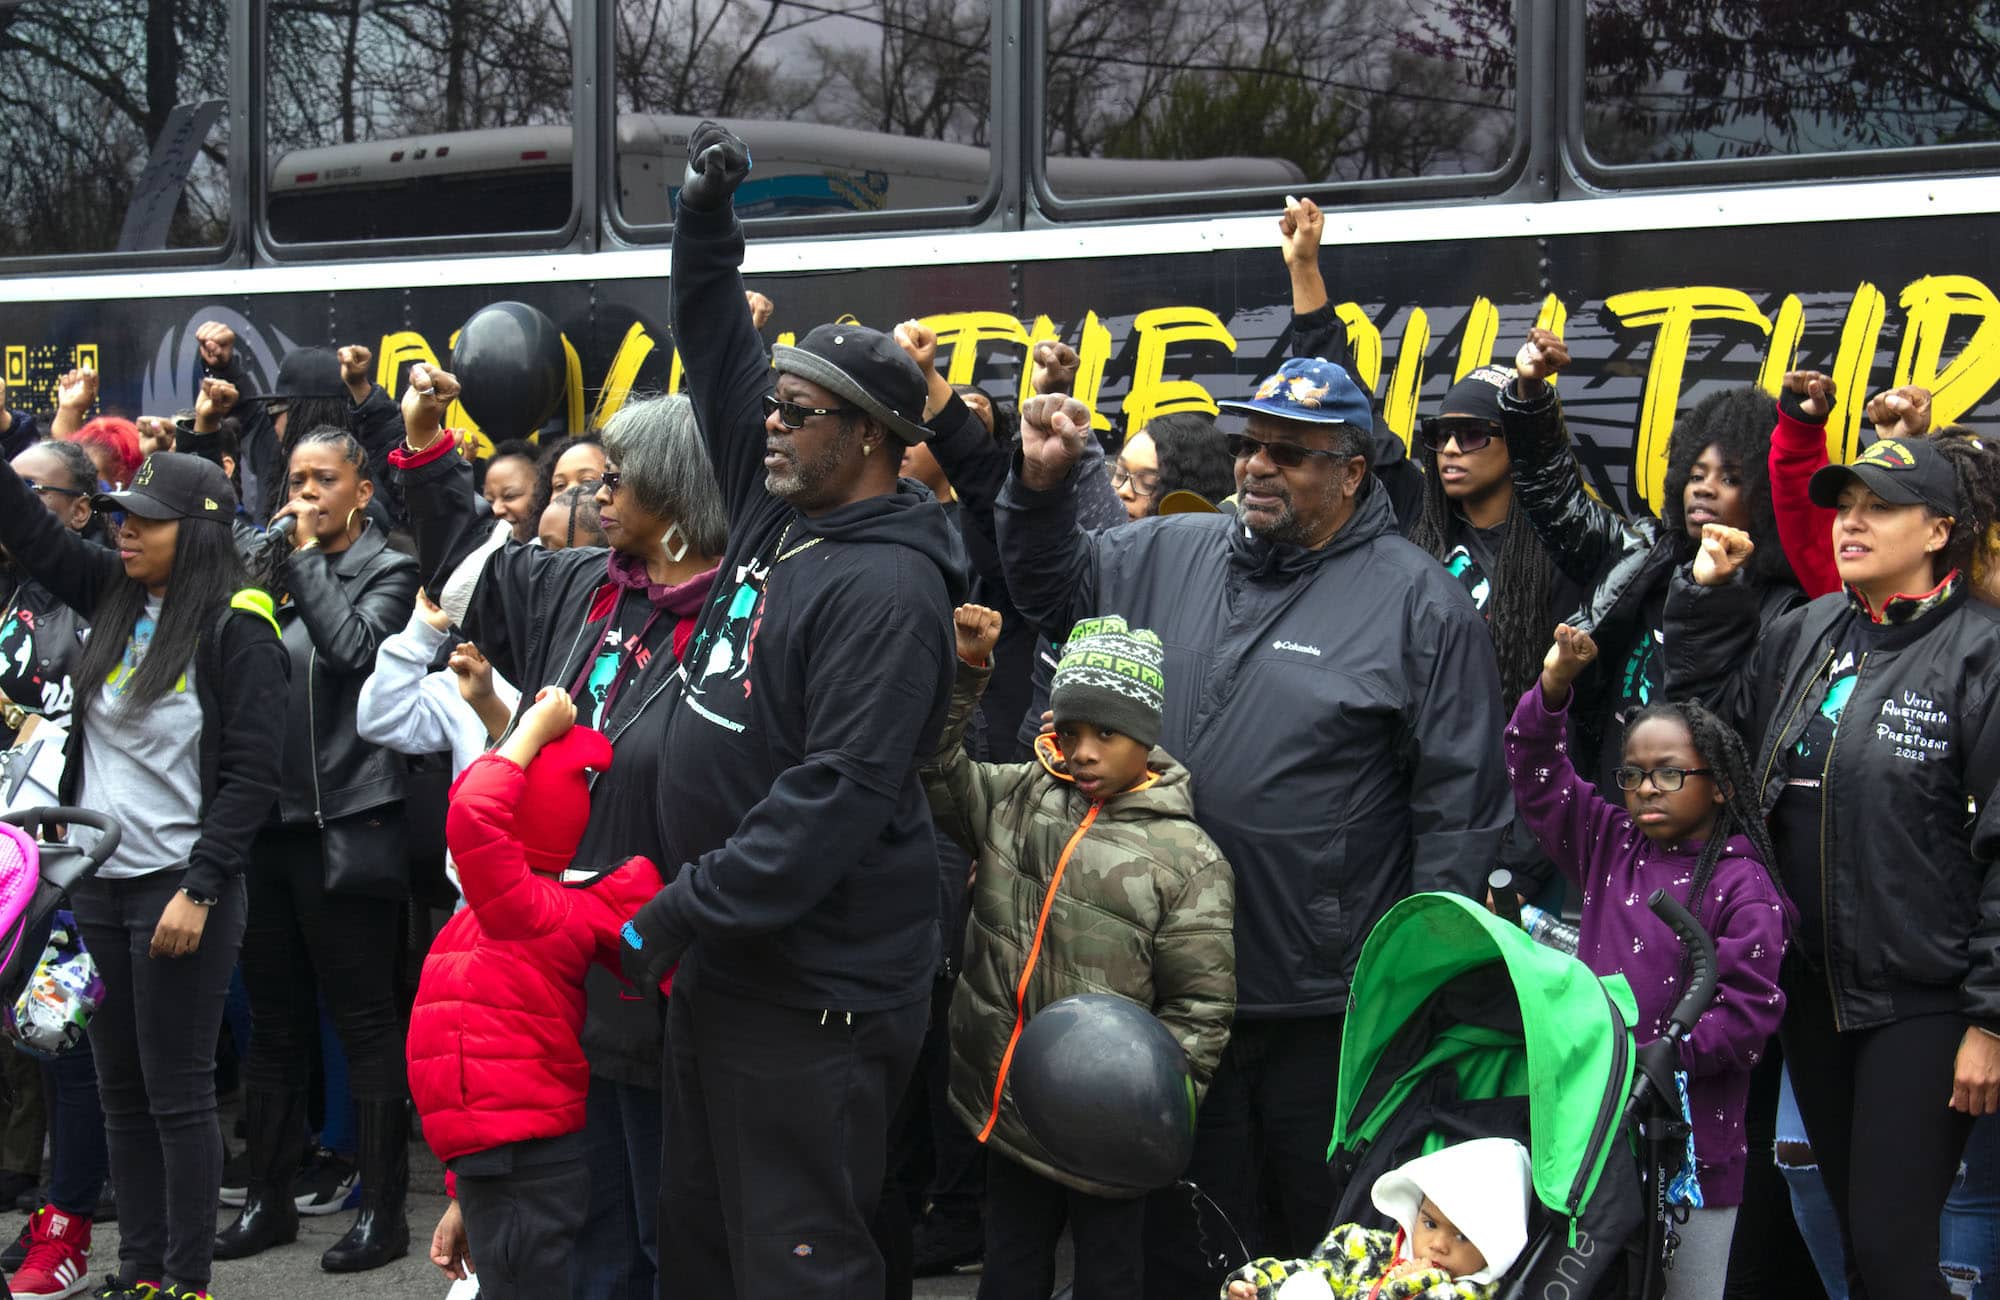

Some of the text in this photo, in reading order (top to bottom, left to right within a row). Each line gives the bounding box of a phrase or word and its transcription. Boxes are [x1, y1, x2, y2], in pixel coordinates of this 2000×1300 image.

[1281, 640, 1321, 656] Columbia
[1657, 1165, 1666, 1222] summer
[1543, 1230, 1595, 1300] one
